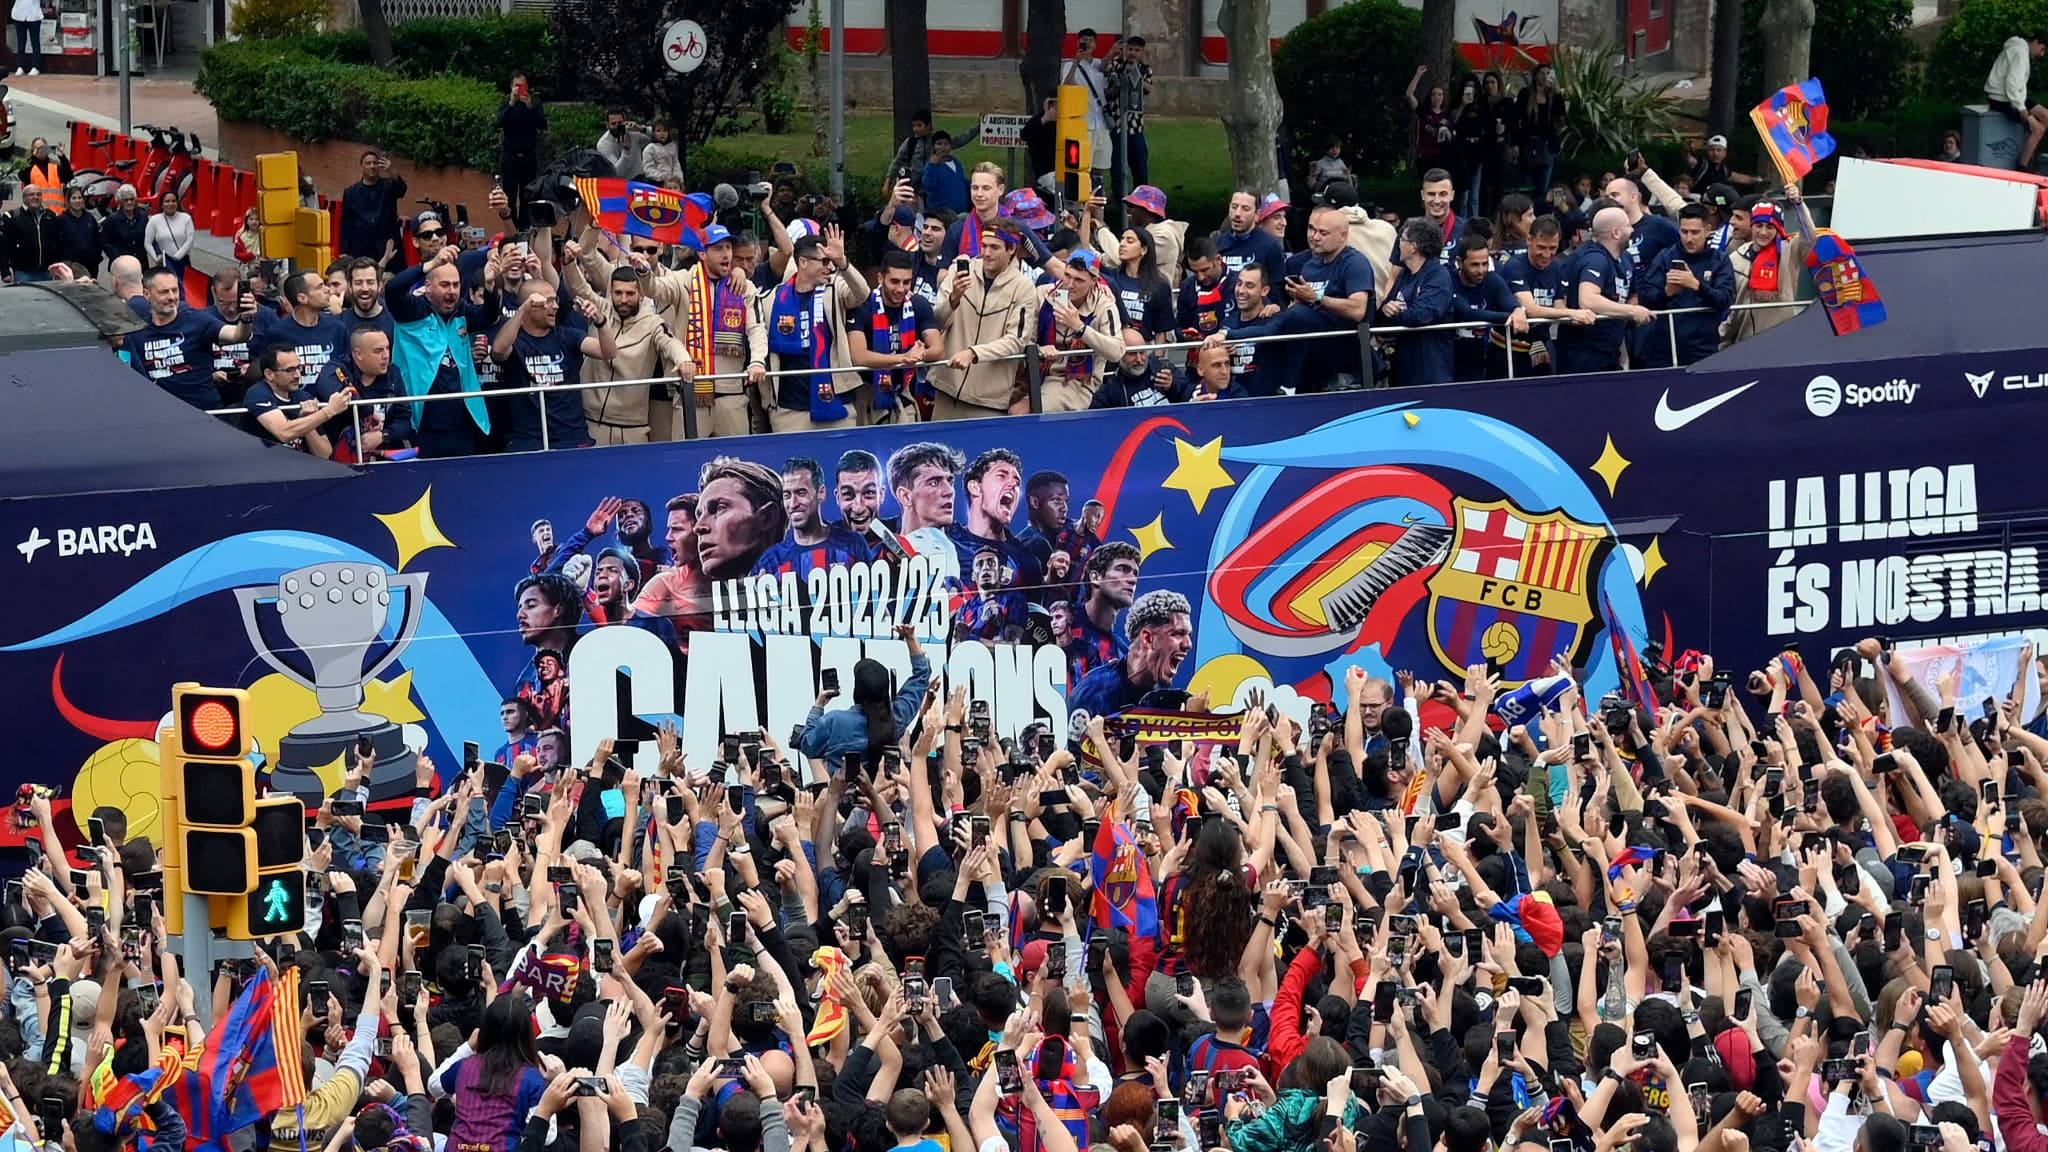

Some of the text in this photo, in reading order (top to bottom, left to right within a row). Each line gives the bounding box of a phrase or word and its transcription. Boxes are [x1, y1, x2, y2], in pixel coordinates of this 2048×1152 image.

[1845, 379, 1917, 407] Spotify
[57, 522, 157, 557] BARÇA
[1769, 464, 1978, 549] LA LLIGA
[712, 552, 950, 641] LLIGA 2022/23
[1767, 549, 1830, 635] ÉS
